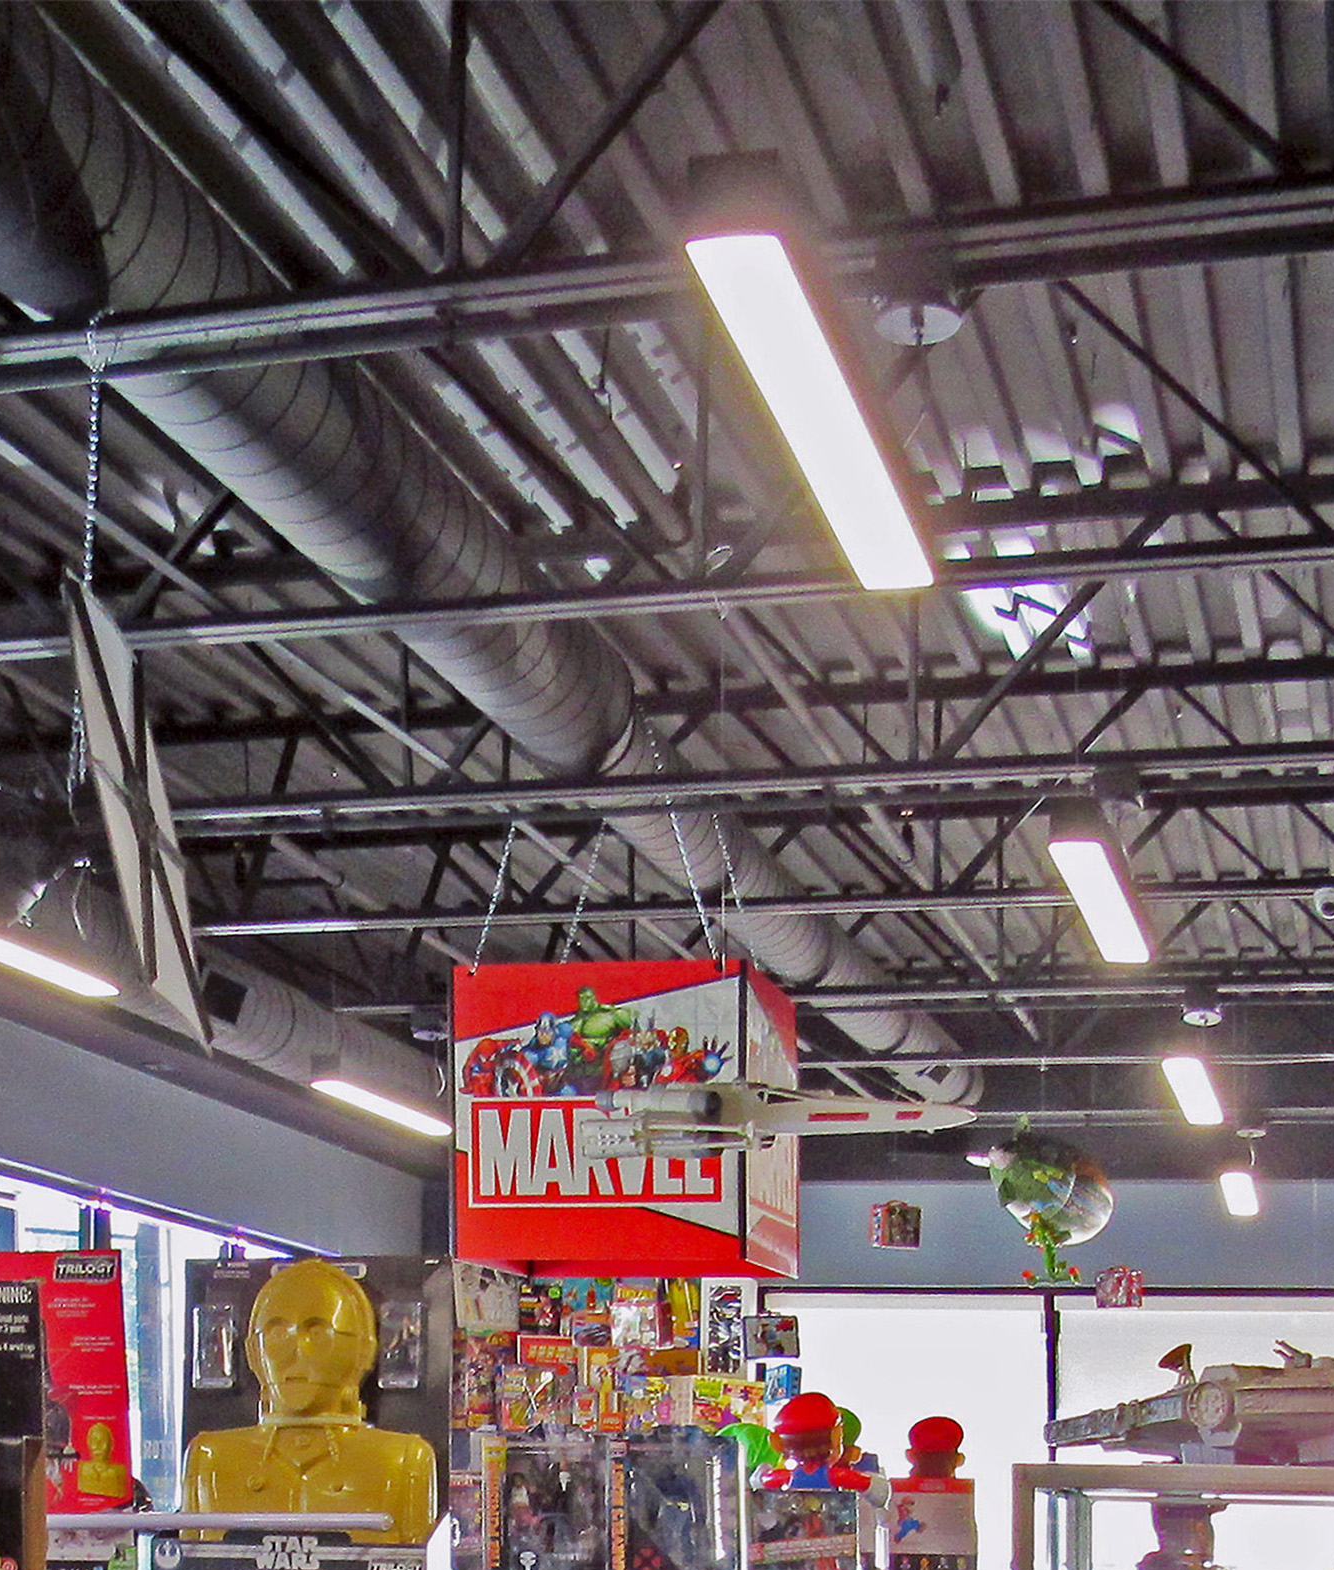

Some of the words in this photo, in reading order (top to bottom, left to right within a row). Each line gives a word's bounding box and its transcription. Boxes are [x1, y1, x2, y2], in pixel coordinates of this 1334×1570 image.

[56, 1261, 114, 1275] TRILOGY
[261, 1535, 319, 1552] STAR
[254, 1552, 321, 1570] WARS
